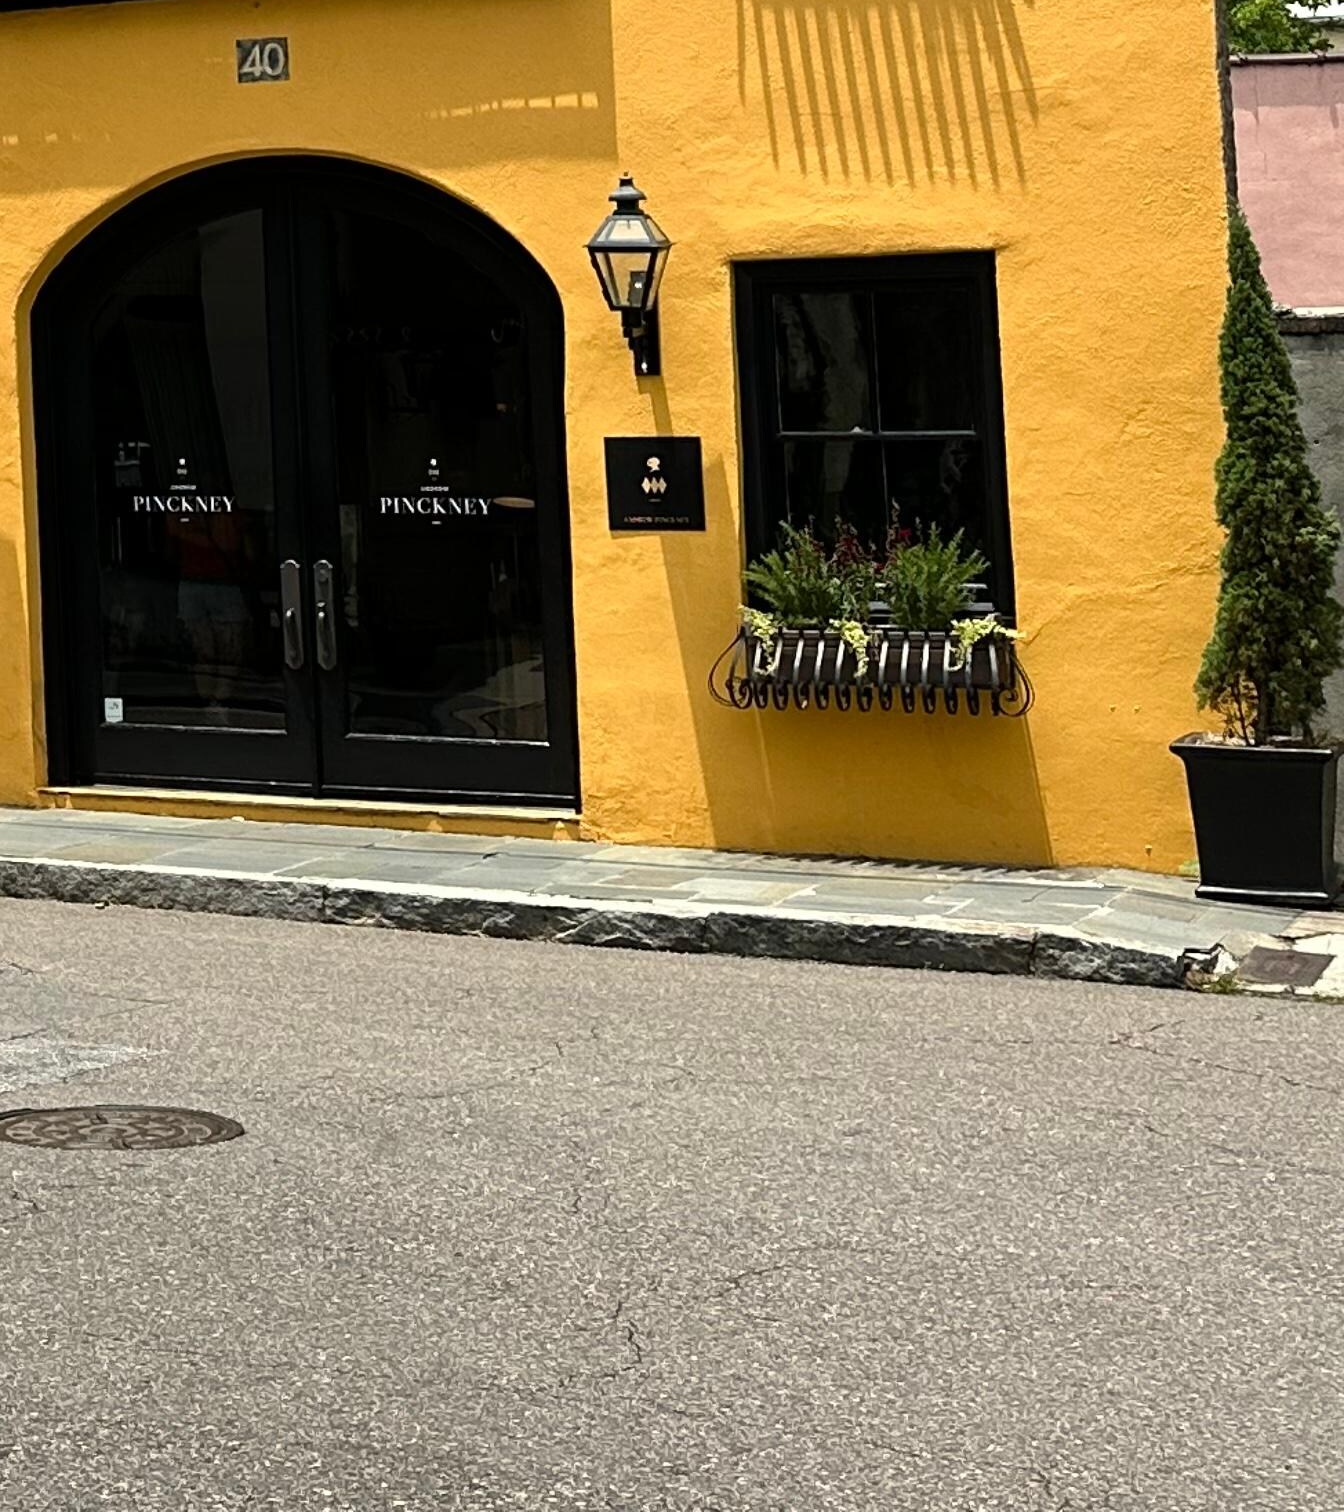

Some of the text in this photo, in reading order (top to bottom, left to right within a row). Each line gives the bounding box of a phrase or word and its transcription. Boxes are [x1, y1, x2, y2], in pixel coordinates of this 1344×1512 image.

[239, 43, 285, 77] 40
[133, 495, 235, 512] PINCKNEY
[380, 497, 492, 515] PINCKNEY
